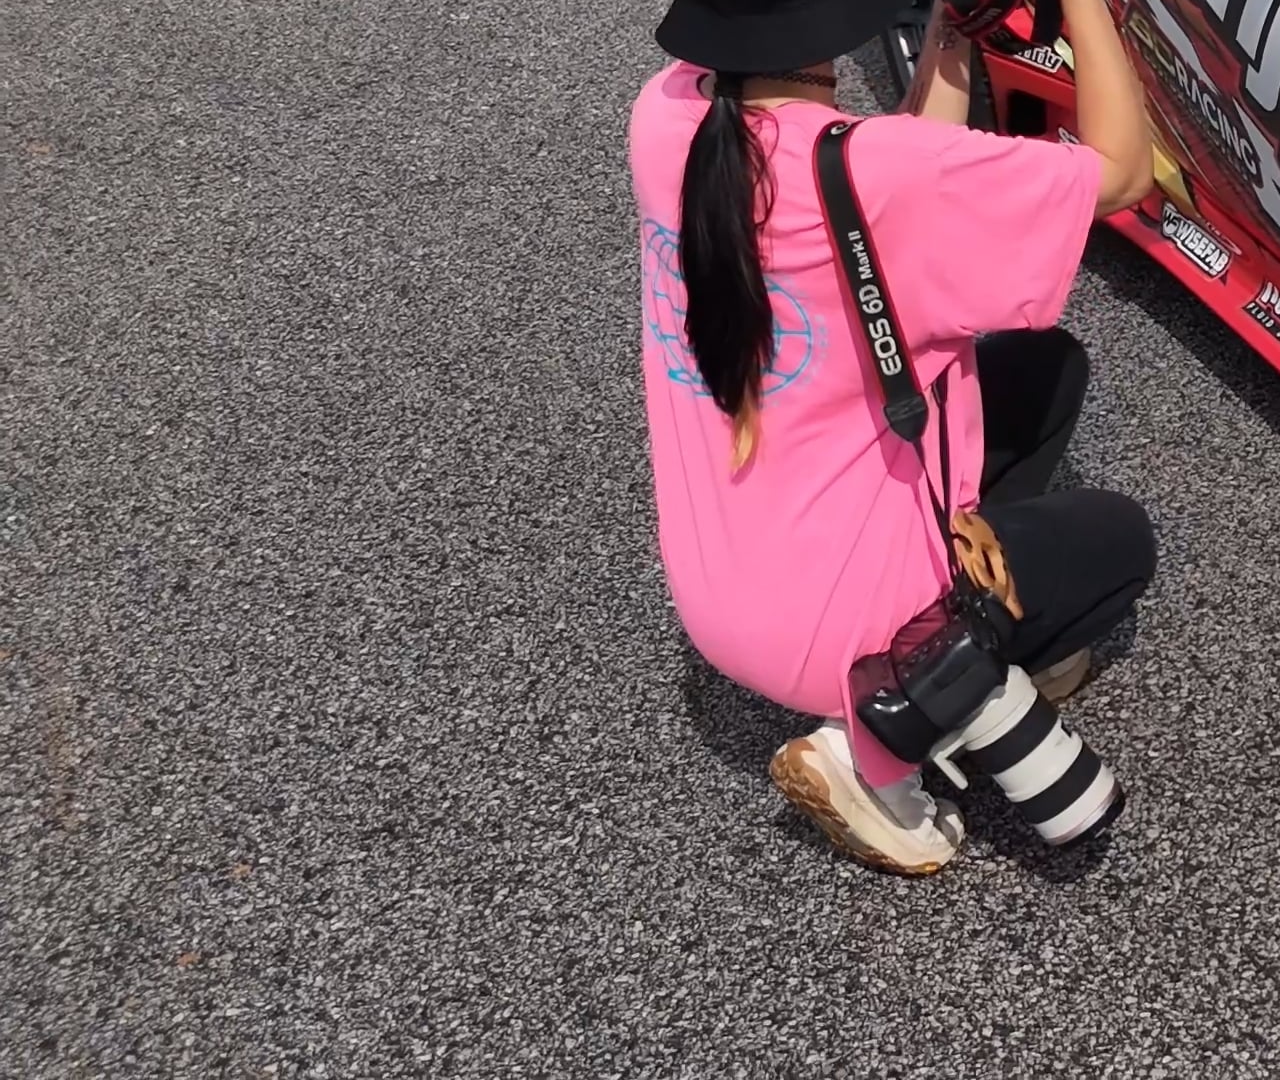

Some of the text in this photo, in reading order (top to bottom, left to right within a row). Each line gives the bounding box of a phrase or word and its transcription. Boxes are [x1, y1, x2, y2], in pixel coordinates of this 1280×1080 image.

[1174, 55, 1257, 174] RACING
[851, 243, 874, 281] Mark
[1177, 222, 1229, 273] WISEFAB
[858, 283, 884, 315] 6D
[1245, 302, 1274, 328] FLUID
[868, 317, 902, 376] EOS
